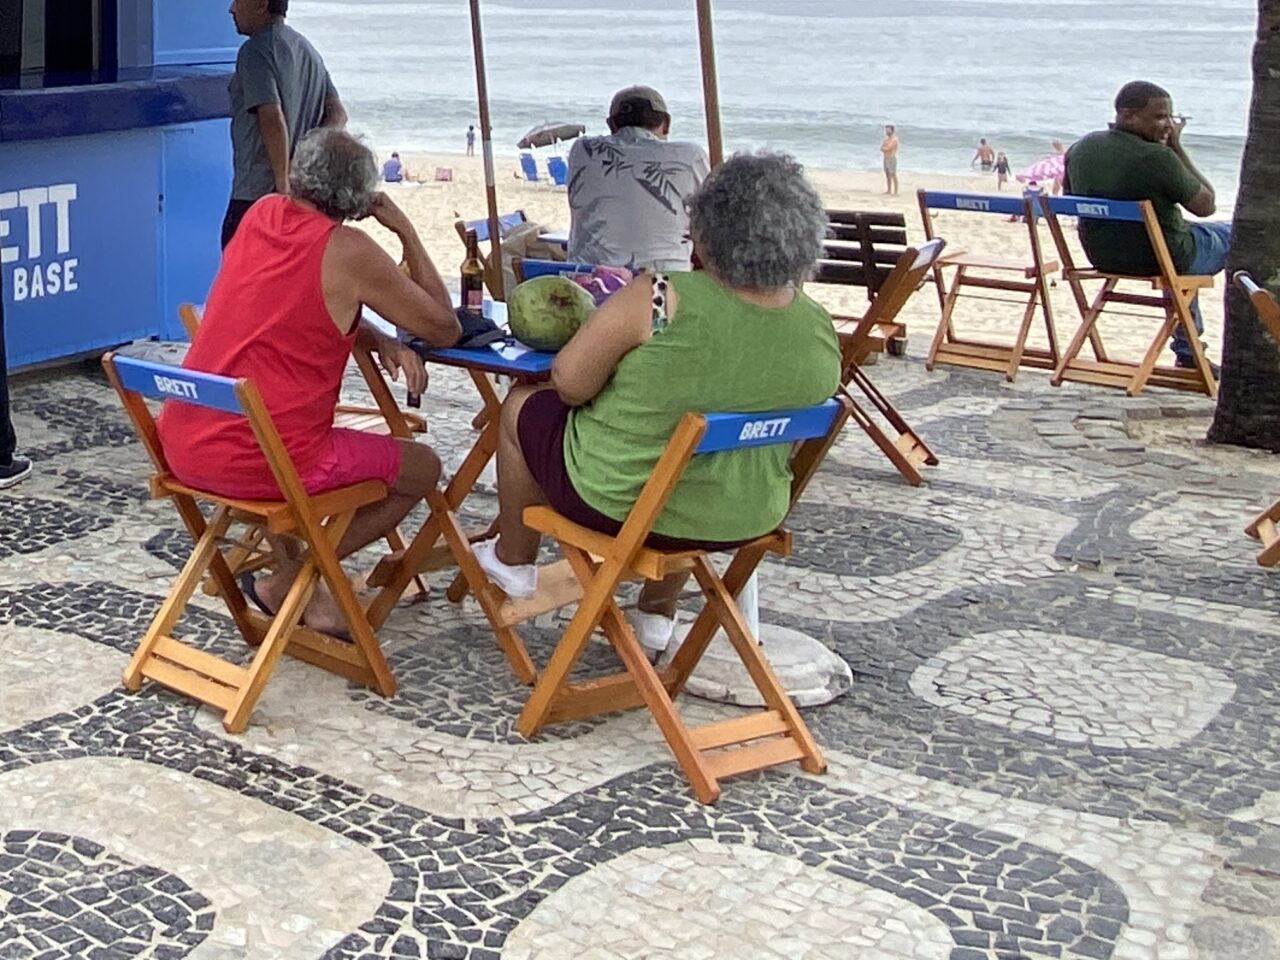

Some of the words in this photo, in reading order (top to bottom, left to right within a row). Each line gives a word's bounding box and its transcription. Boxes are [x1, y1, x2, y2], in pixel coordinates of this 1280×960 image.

[13, 258, 78, 301] BASE
[153, 375, 198, 399] BRETT
[739, 417, 791, 441] BRETT
